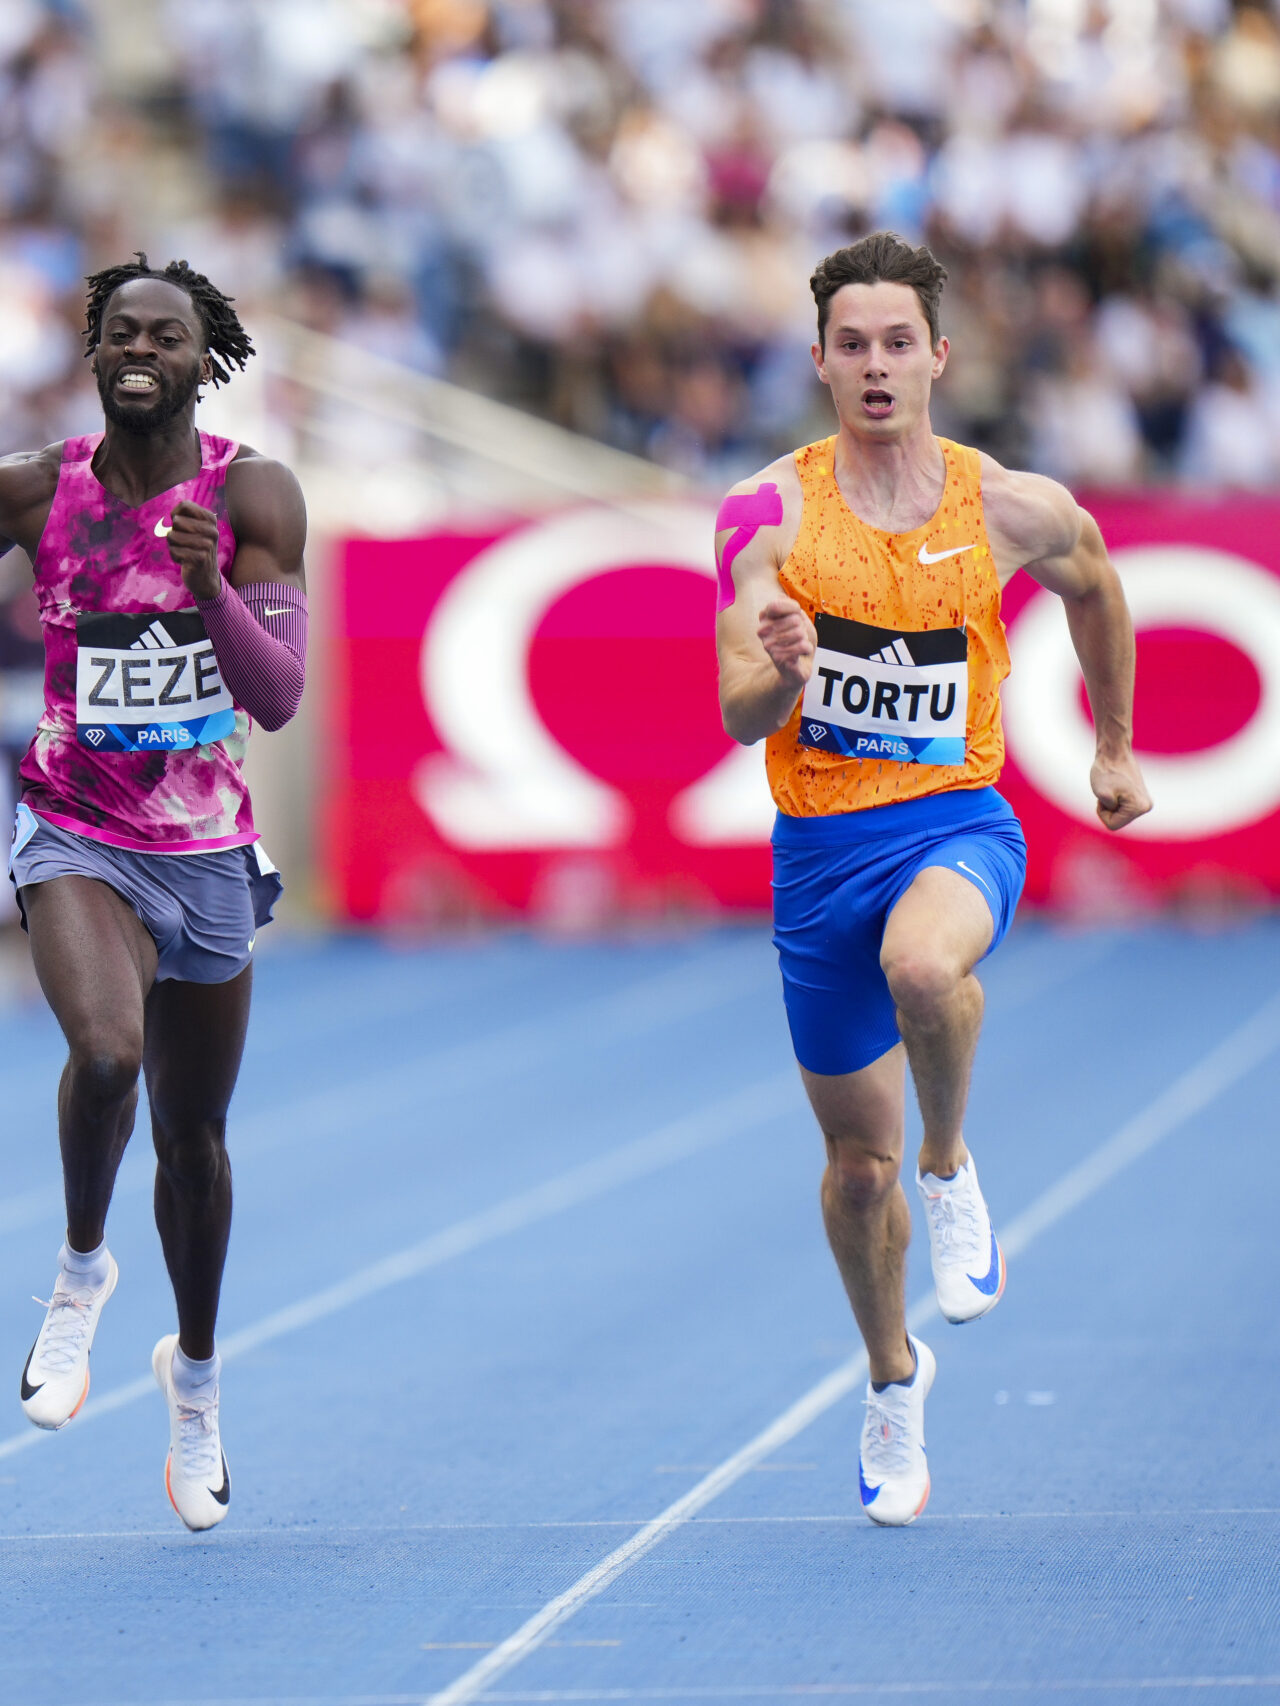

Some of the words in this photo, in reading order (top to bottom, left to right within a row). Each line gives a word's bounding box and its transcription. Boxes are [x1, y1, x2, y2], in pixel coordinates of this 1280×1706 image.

[88, 648, 222, 708] ZEZE
[817, 666, 956, 723] TORTU
[137, 728, 190, 744] PARIS
[856, 738, 909, 756] PARIS
